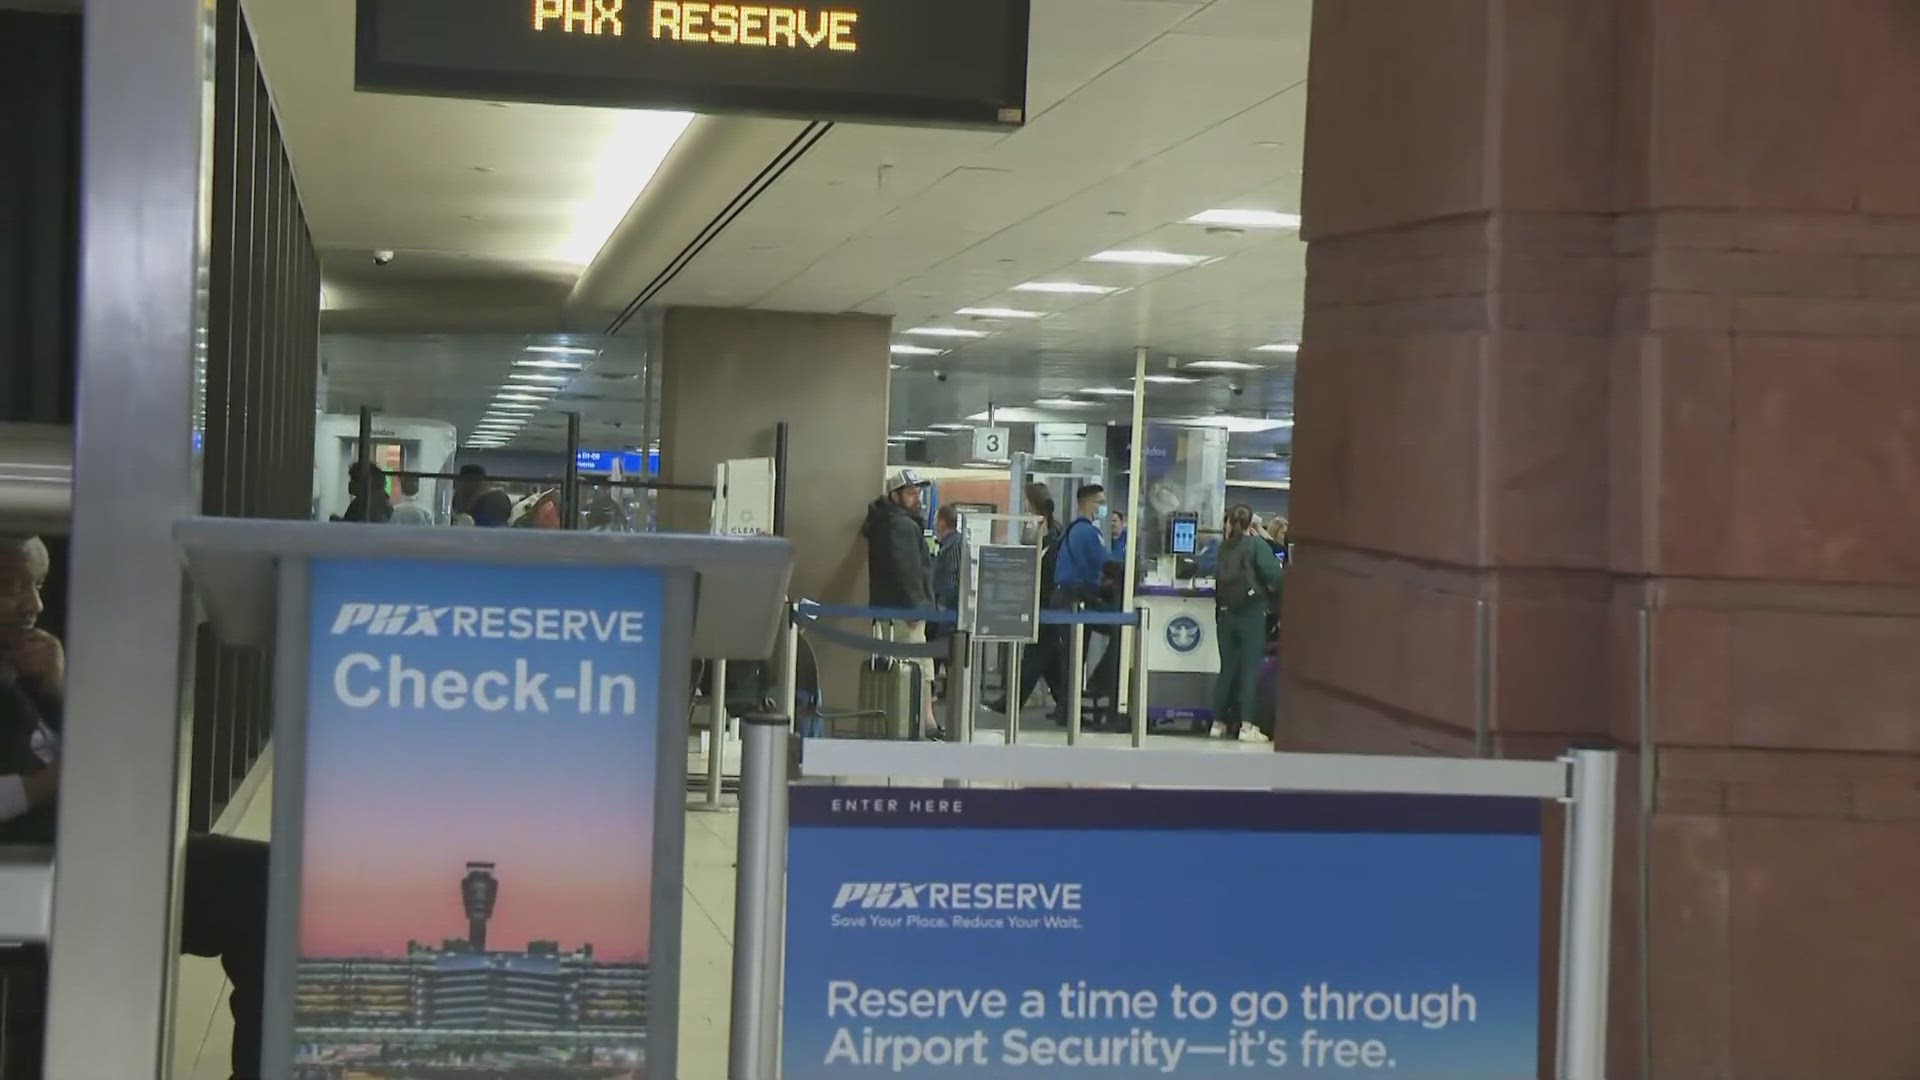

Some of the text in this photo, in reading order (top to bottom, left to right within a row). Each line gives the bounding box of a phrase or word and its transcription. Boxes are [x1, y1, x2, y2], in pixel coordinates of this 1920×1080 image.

[533, 0, 857, 51] PHX RESERVE
[986, 434, 1000, 453] 3
[452, 605, 645, 642] RESERVE
[333, 652, 638, 716] Check-In
[831, 799, 964, 814] ENTER HERE
[929, 882, 1082, 911] RESERVE
[831, 913, 1083, 930] Save Your Place. Reduce Your Wait.
[827, 980, 1477, 1029] Reserve a time to go through
[824, 1026, 988, 1072] Airport
[1301, 1029, 1396, 1069] free.
